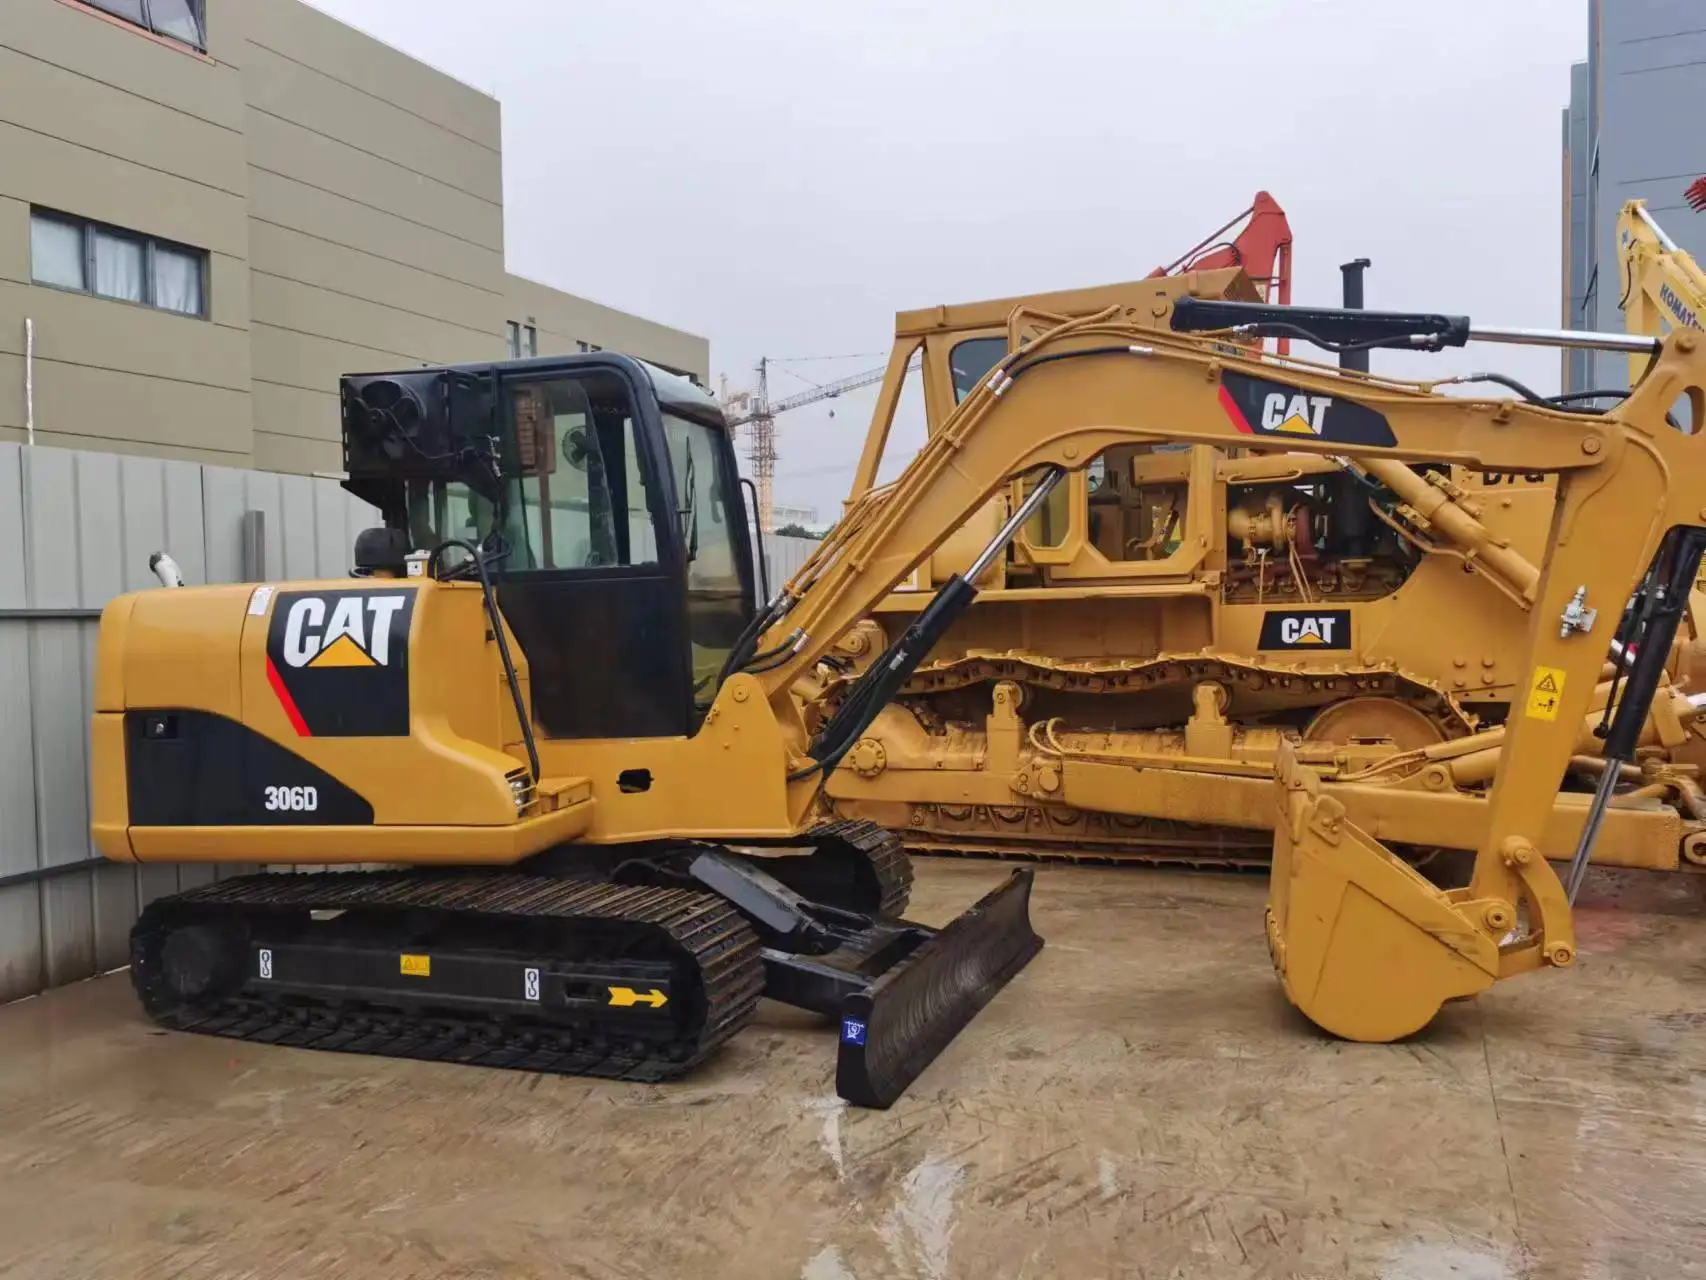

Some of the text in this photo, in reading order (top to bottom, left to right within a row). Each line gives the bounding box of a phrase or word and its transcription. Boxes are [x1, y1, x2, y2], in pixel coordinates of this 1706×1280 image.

[1660, 282, 1705, 333] KOMAT
[1261, 392, 1333, 435] CAT
[283, 596, 406, 668] CAT
[1281, 617, 1336, 644] CAT
[264, 785, 318, 811] 306D
